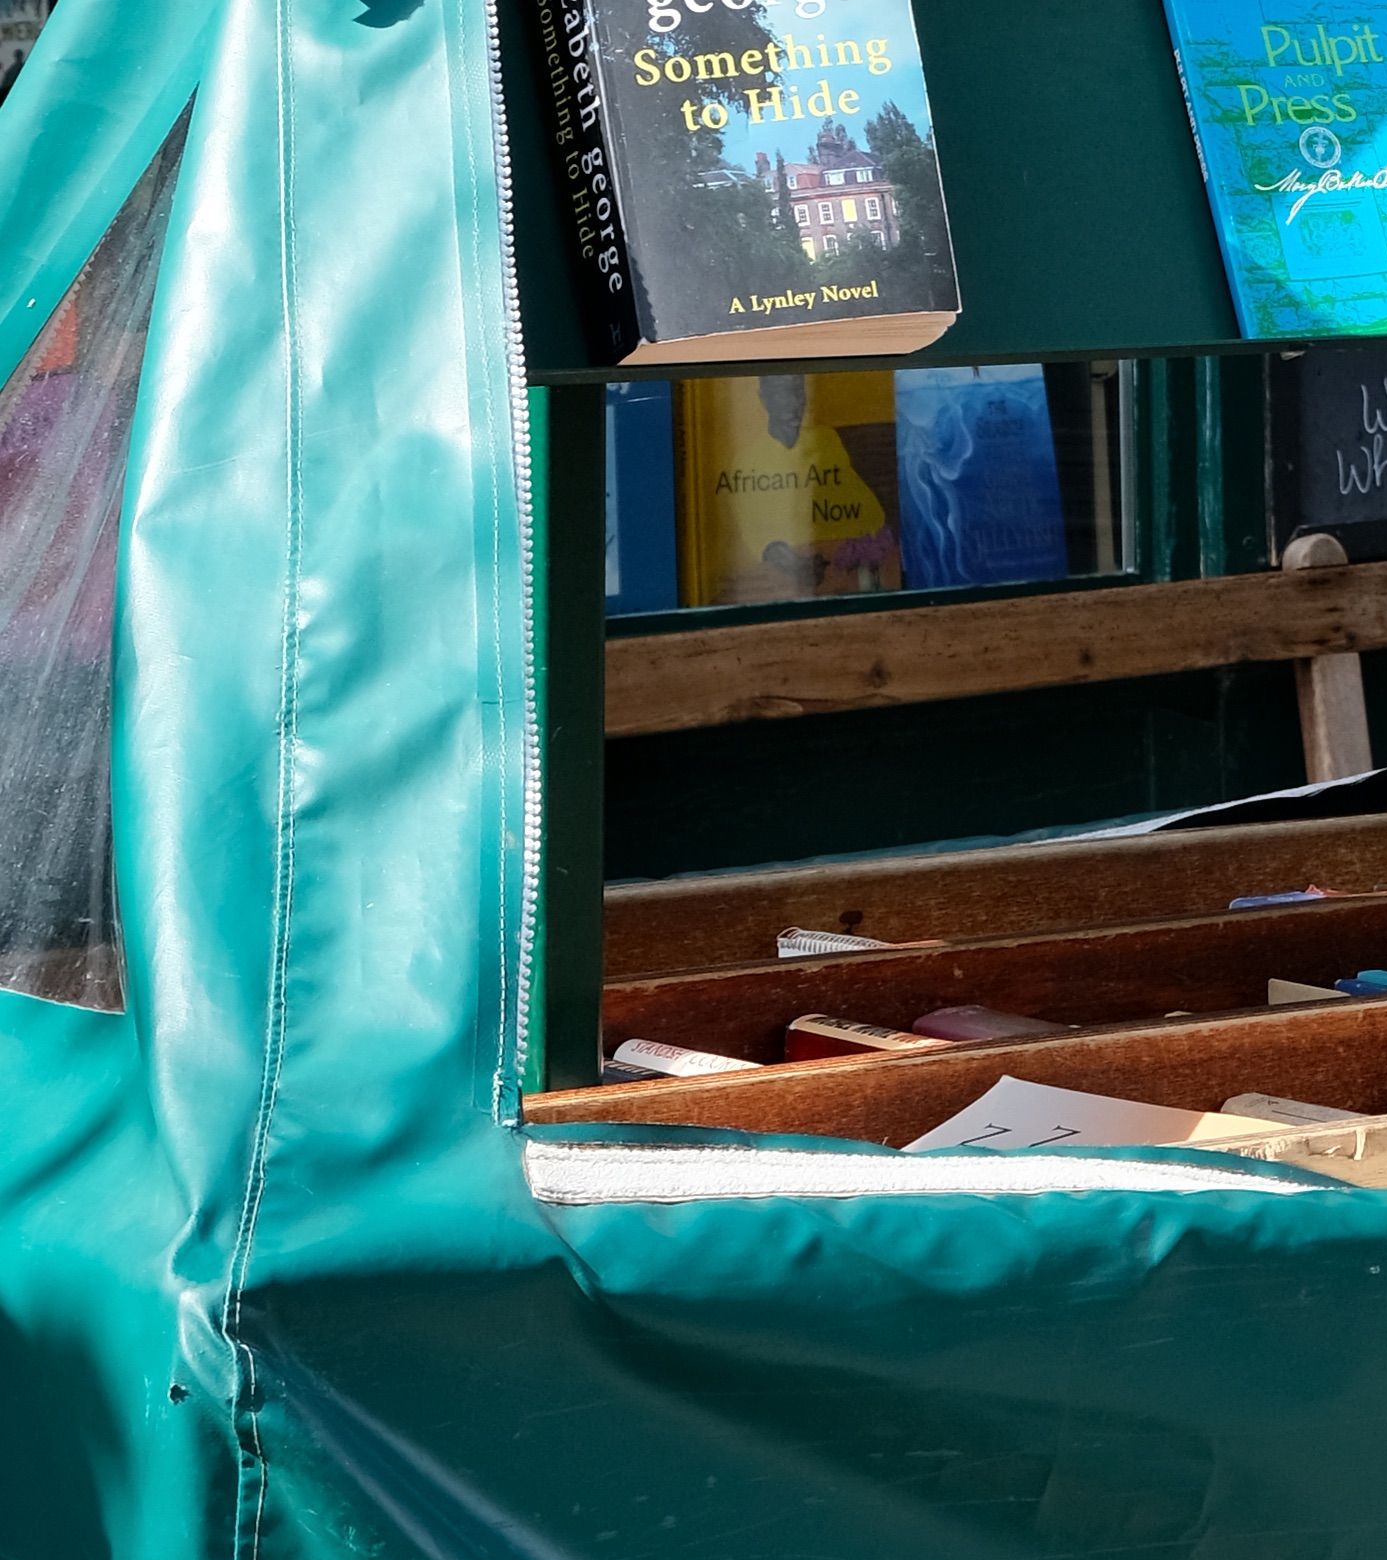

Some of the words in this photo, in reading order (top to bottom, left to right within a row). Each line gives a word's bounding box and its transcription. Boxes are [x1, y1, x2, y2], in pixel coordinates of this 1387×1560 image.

[633, 33, 891, 86] Something
[1261, 25, 1384, 77] Pulpit
[1284, 73, 1325, 88] AND
[680, 98, 729, 131] to
[742, 79, 860, 126] Hide
[1237, 84, 1356, 126] Press
[728, 297, 745, 315] A
[749, 290, 816, 316] Lynley
[822, 281, 879, 305] Novel
[715, 467, 798, 496] African
[804, 463, 841, 488] Art
[811, 498, 861, 523] Now
